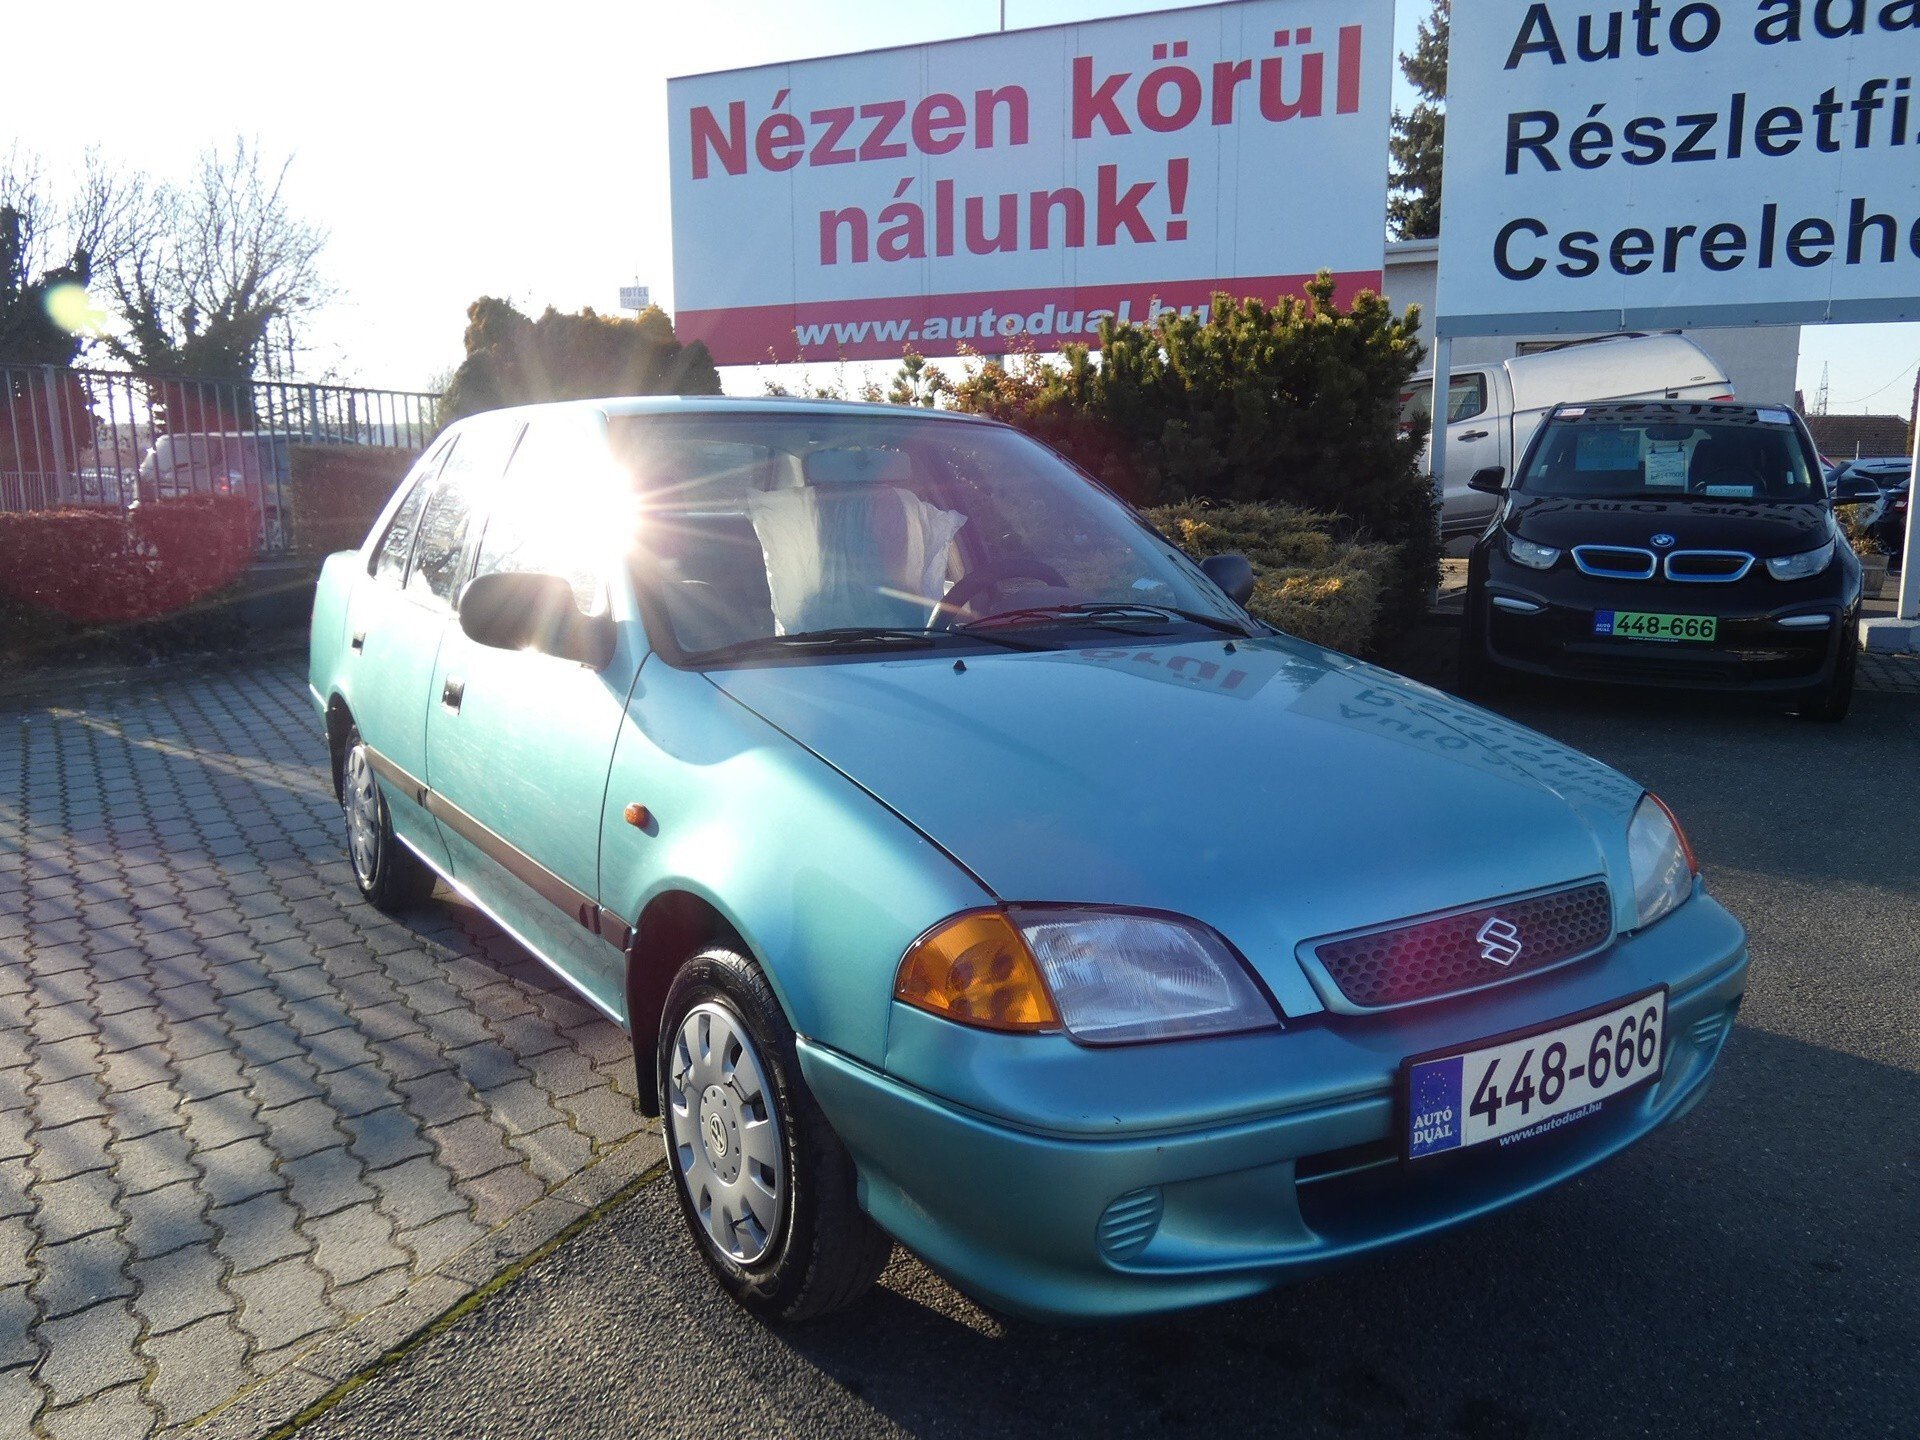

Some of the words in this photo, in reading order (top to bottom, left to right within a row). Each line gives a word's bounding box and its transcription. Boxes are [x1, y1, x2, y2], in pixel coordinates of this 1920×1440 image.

[689, 83, 1029, 180] Nézzen
[1072, 25, 1362, 139] körül
[1505, 77, 1920, 175] Részletfi
[819, 157, 1190, 266] nálunk!
[1493, 198, 1920, 281] Csereleh
[620, 287, 649, 297] HOTEL
[1617, 615, 1714, 638] 448-666
[1469, 1006, 1658, 1126] 448-666
[1413, 1106, 1453, 1130] AUTÓ
[1413, 1126, 1453, 1146] DUAL
[1500, 1101, 1602, 1146] www.autodual.hu
